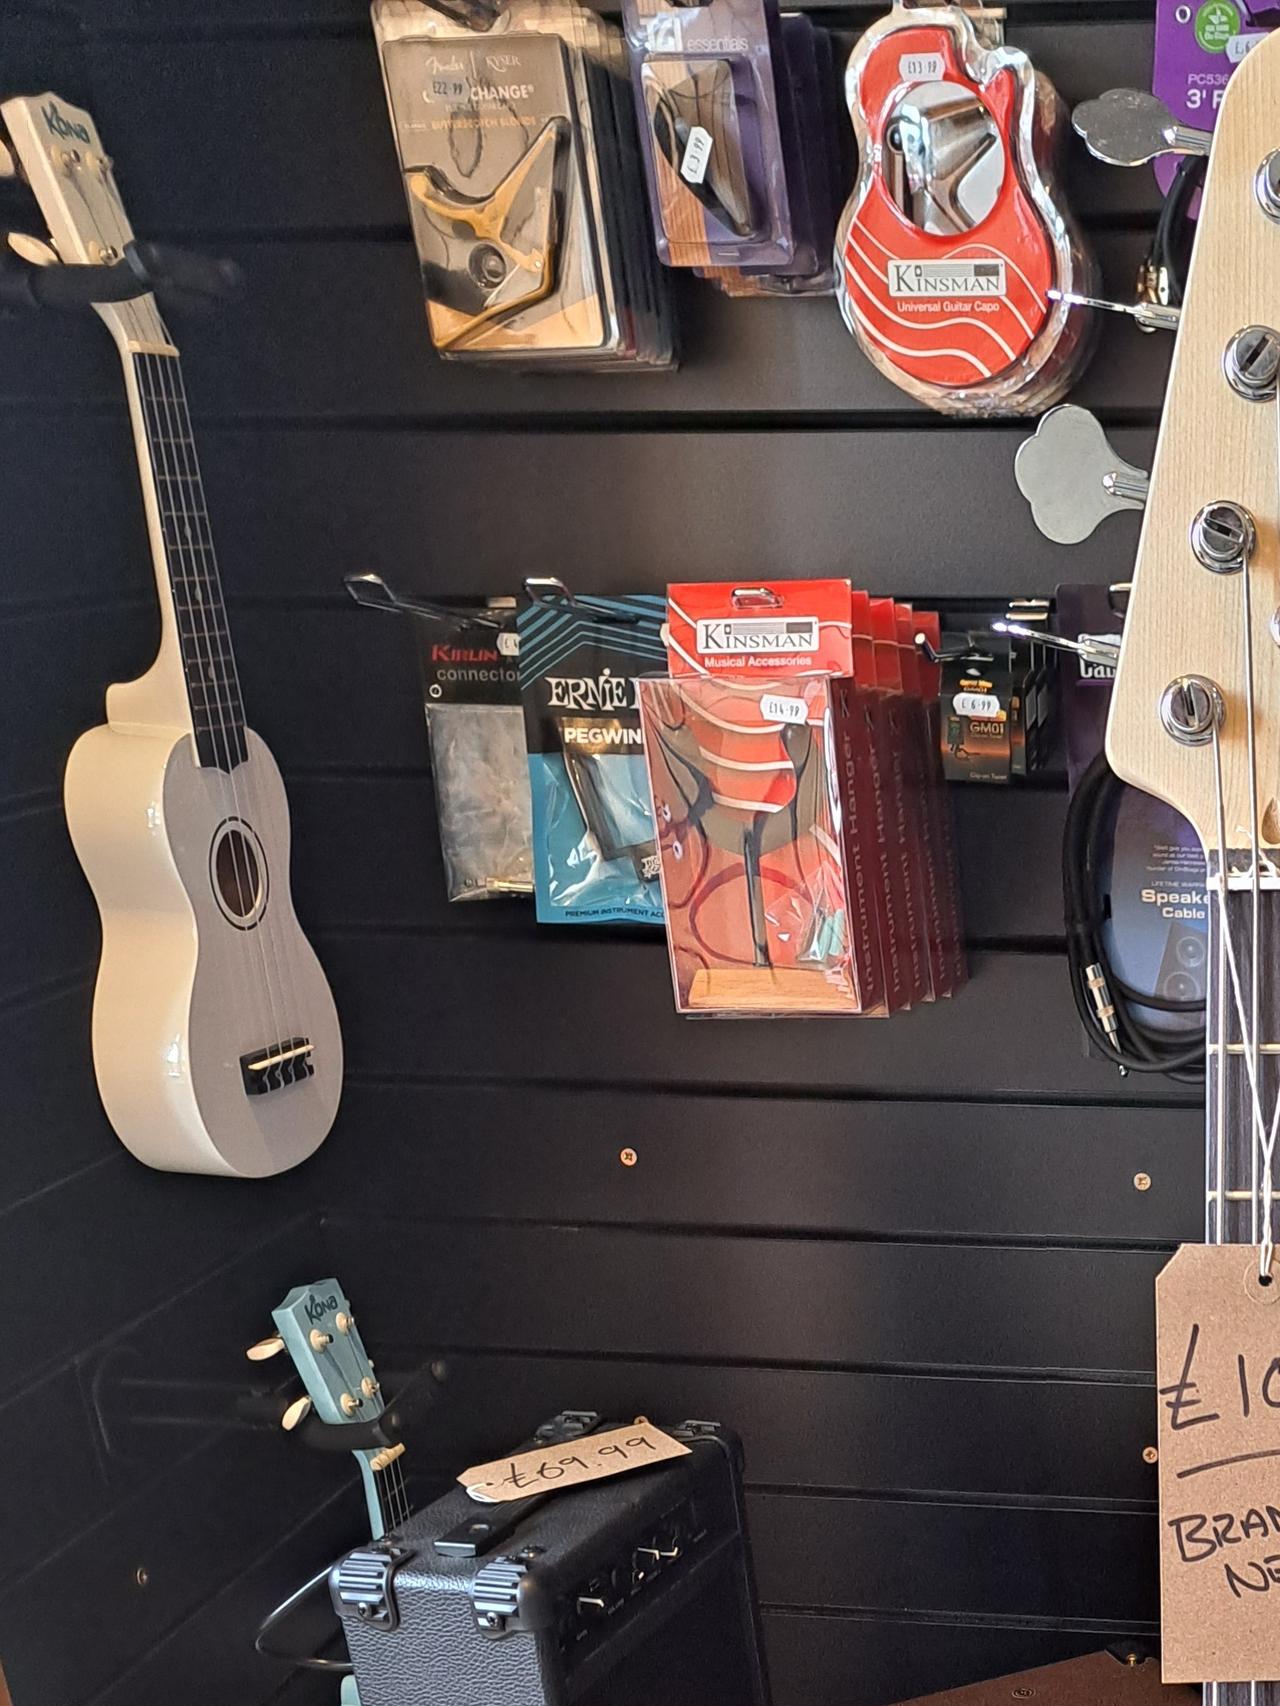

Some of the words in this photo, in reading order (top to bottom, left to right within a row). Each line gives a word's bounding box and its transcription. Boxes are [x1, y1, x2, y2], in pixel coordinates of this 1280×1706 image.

[686, 36, 750, 52] essentials
[894, 263, 1001, 293] KINSMAN
[897, 301, 942, 313] Universal
[943, 301, 973, 313] Guitar
[974, 301, 1000, 313] Capo
[702, 622, 813, 651] KINSMAN
[431, 644, 498, 663] KIRLIN
[704, 655, 746, 669] Musical
[747, 655, 812, 669] Accessories
[1162, 907, 1206, 919] Cable
[503, 1437, 656, 1489] £69.99
